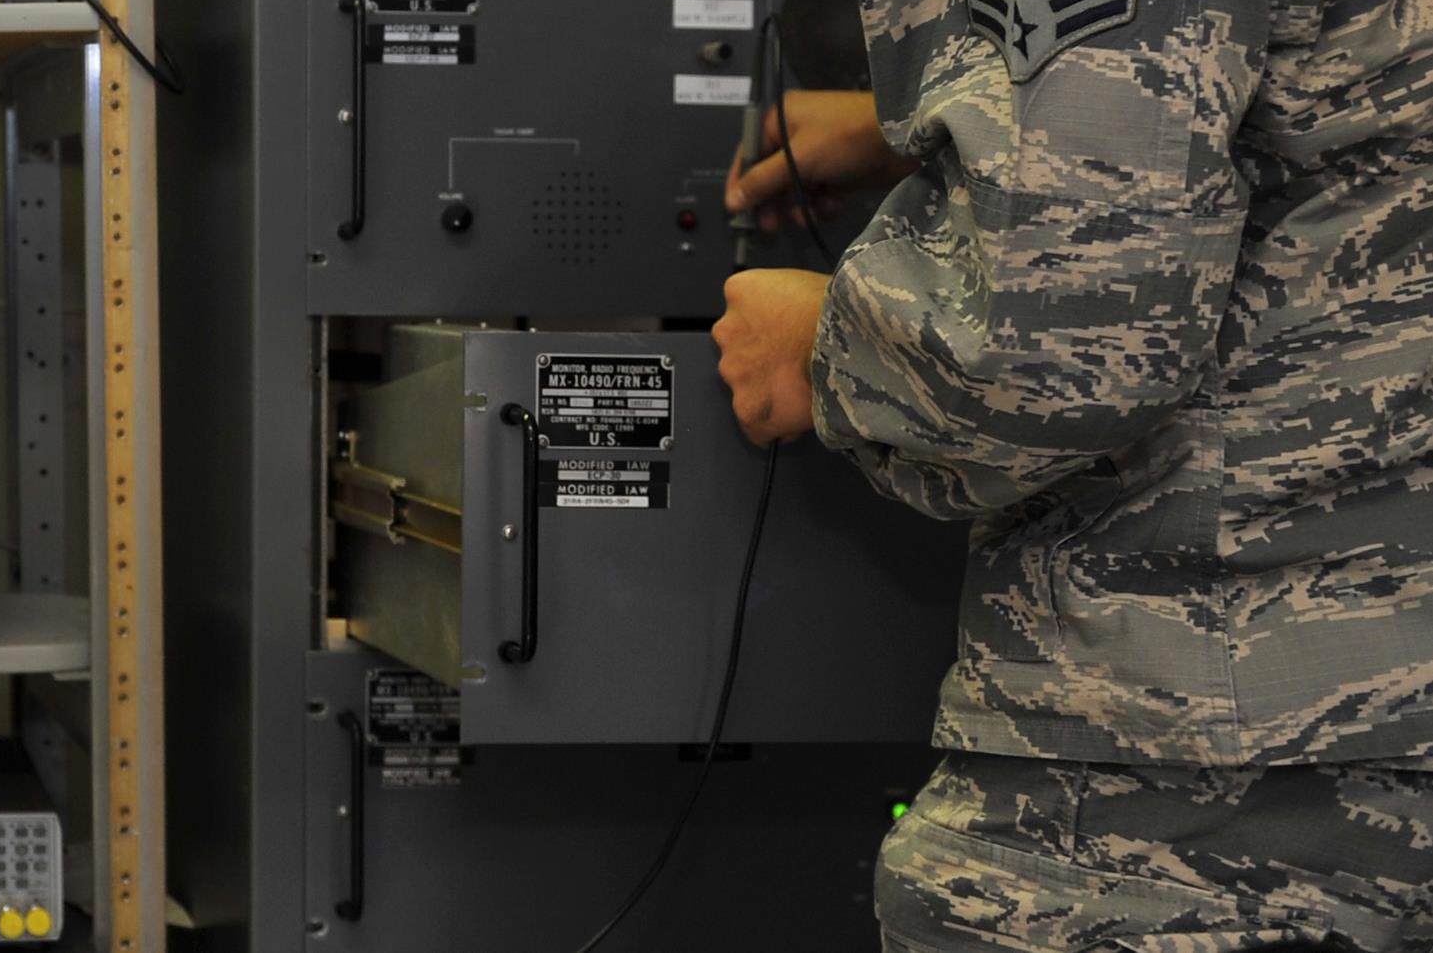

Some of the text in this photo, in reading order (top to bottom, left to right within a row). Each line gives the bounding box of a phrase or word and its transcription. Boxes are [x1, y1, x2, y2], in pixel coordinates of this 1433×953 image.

[591, 365, 614, 373] RADIO
[616, 365, 659, 375] FREQUENCY
[549, 374, 662, 388] MX-10490/FRN-45
[589, 432, 622, 446] U.S.
[558, 460, 650, 471] MODIFIED IAW
[557, 485, 649, 495] MODIFIED IAW
